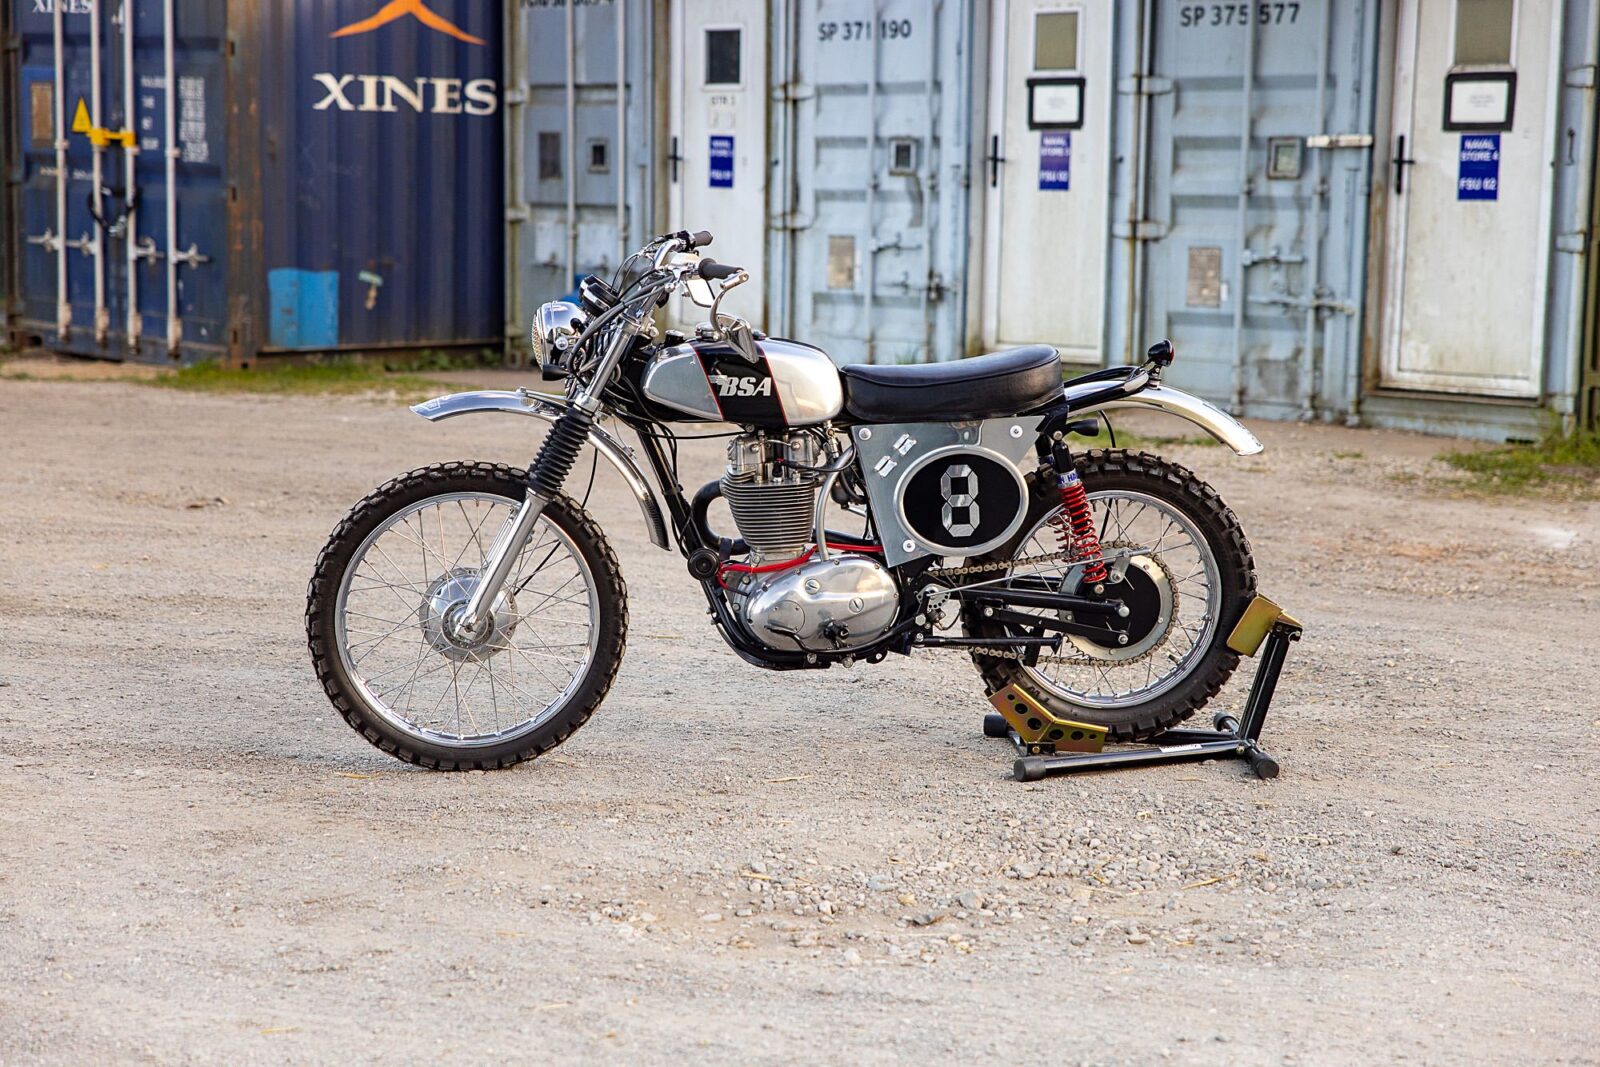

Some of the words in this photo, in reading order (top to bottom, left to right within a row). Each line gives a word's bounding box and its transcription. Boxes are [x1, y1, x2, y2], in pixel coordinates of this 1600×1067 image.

[1180, 6, 1205, 27] SP
[1211, 5, 1248, 26] 375
[1259, 3, 1300, 24] 577
[818, 22, 838, 42] SP
[842, 21, 872, 41] 371
[881, 19, 912, 40] 190
[312, 72, 498, 116] XINES
[1459, 177, 1481, 190] FSU
[719, 377, 772, 396] BSA
[941, 464, 980, 537] 8
